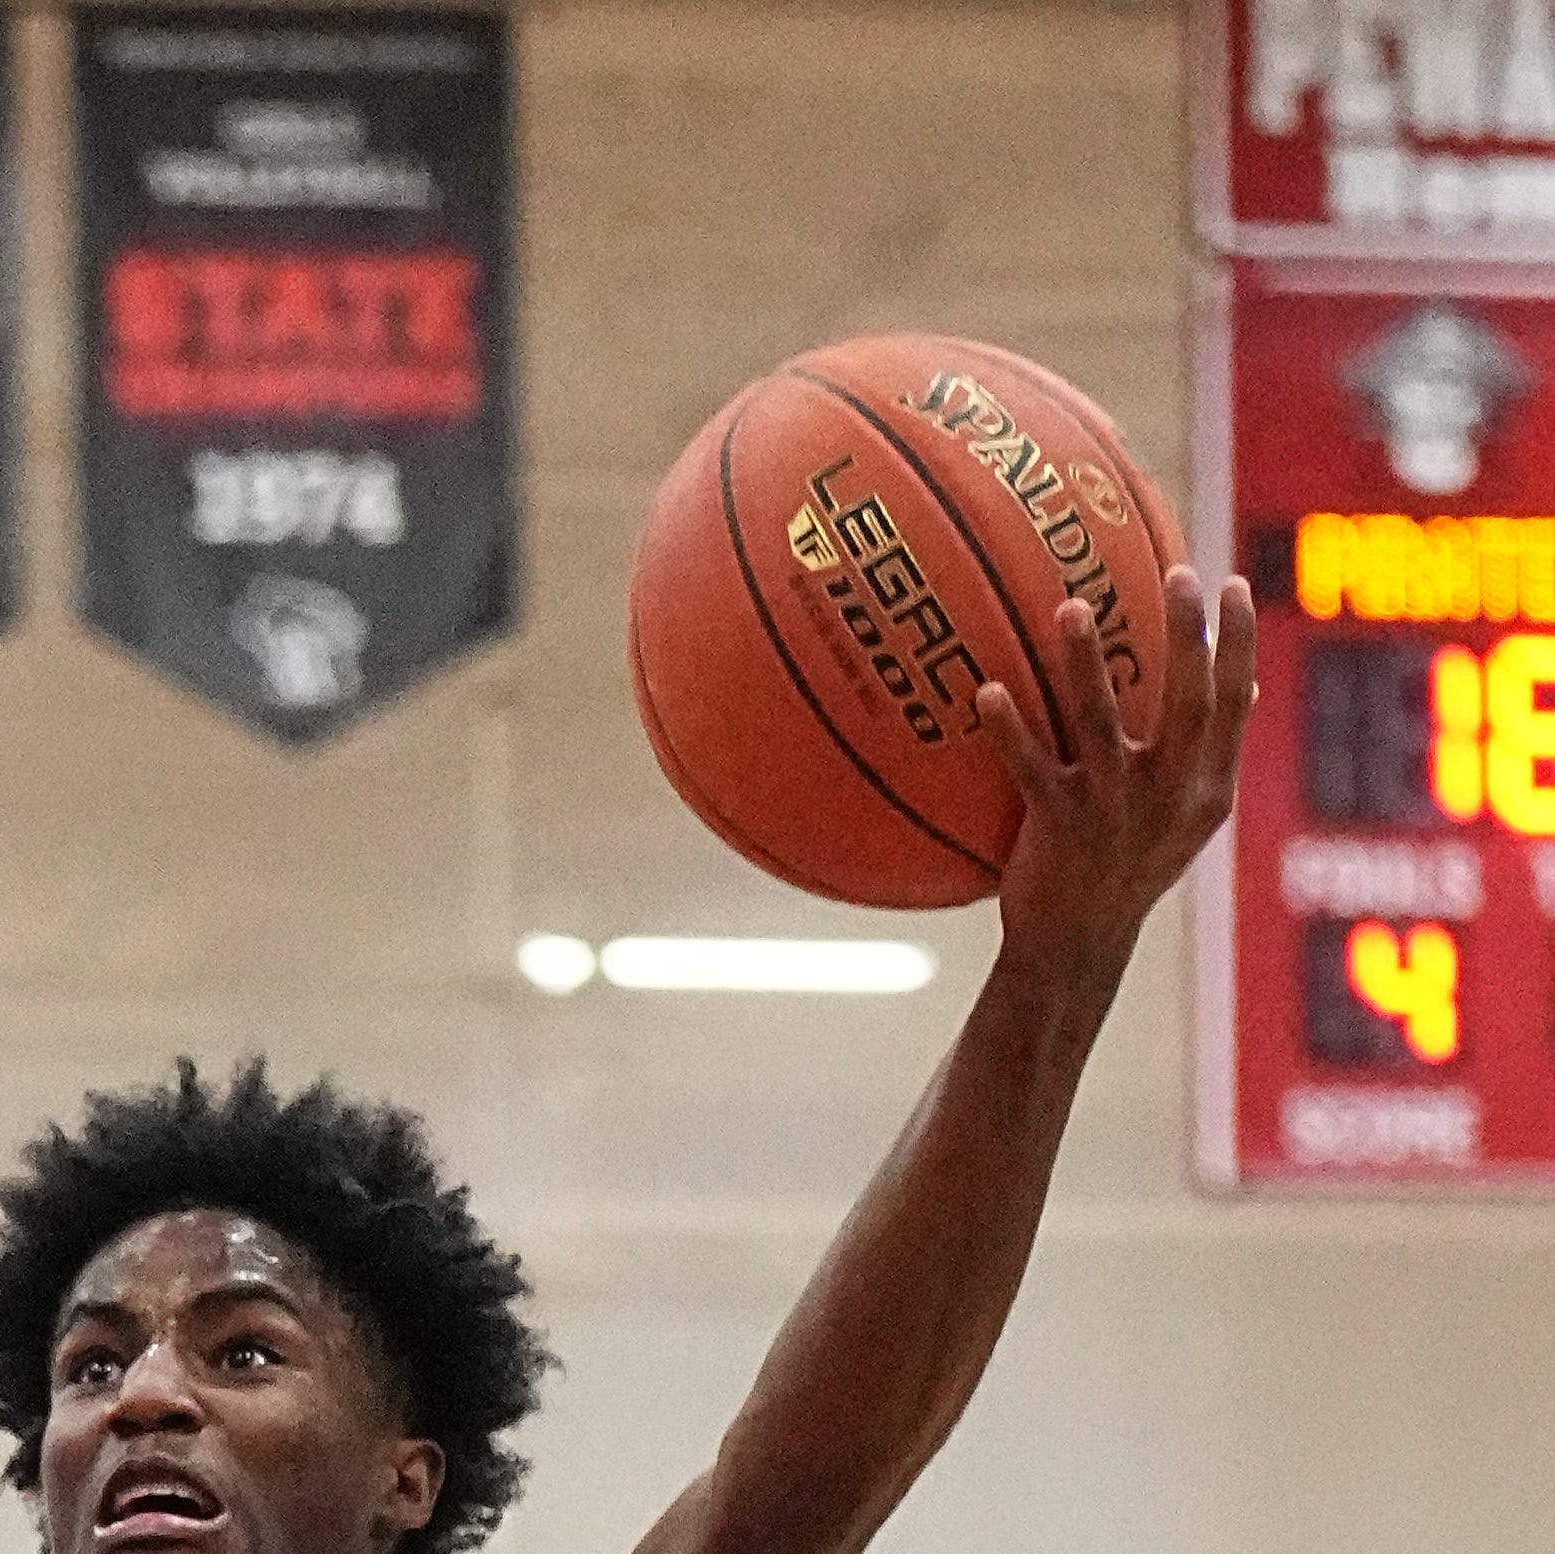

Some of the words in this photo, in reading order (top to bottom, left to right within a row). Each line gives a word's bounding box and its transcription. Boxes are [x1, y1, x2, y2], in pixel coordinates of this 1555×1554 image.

[899, 368, 1141, 697] SPALDING
[826, 574, 944, 734] 1000
[1346, 920, 1460, 1065] 4
